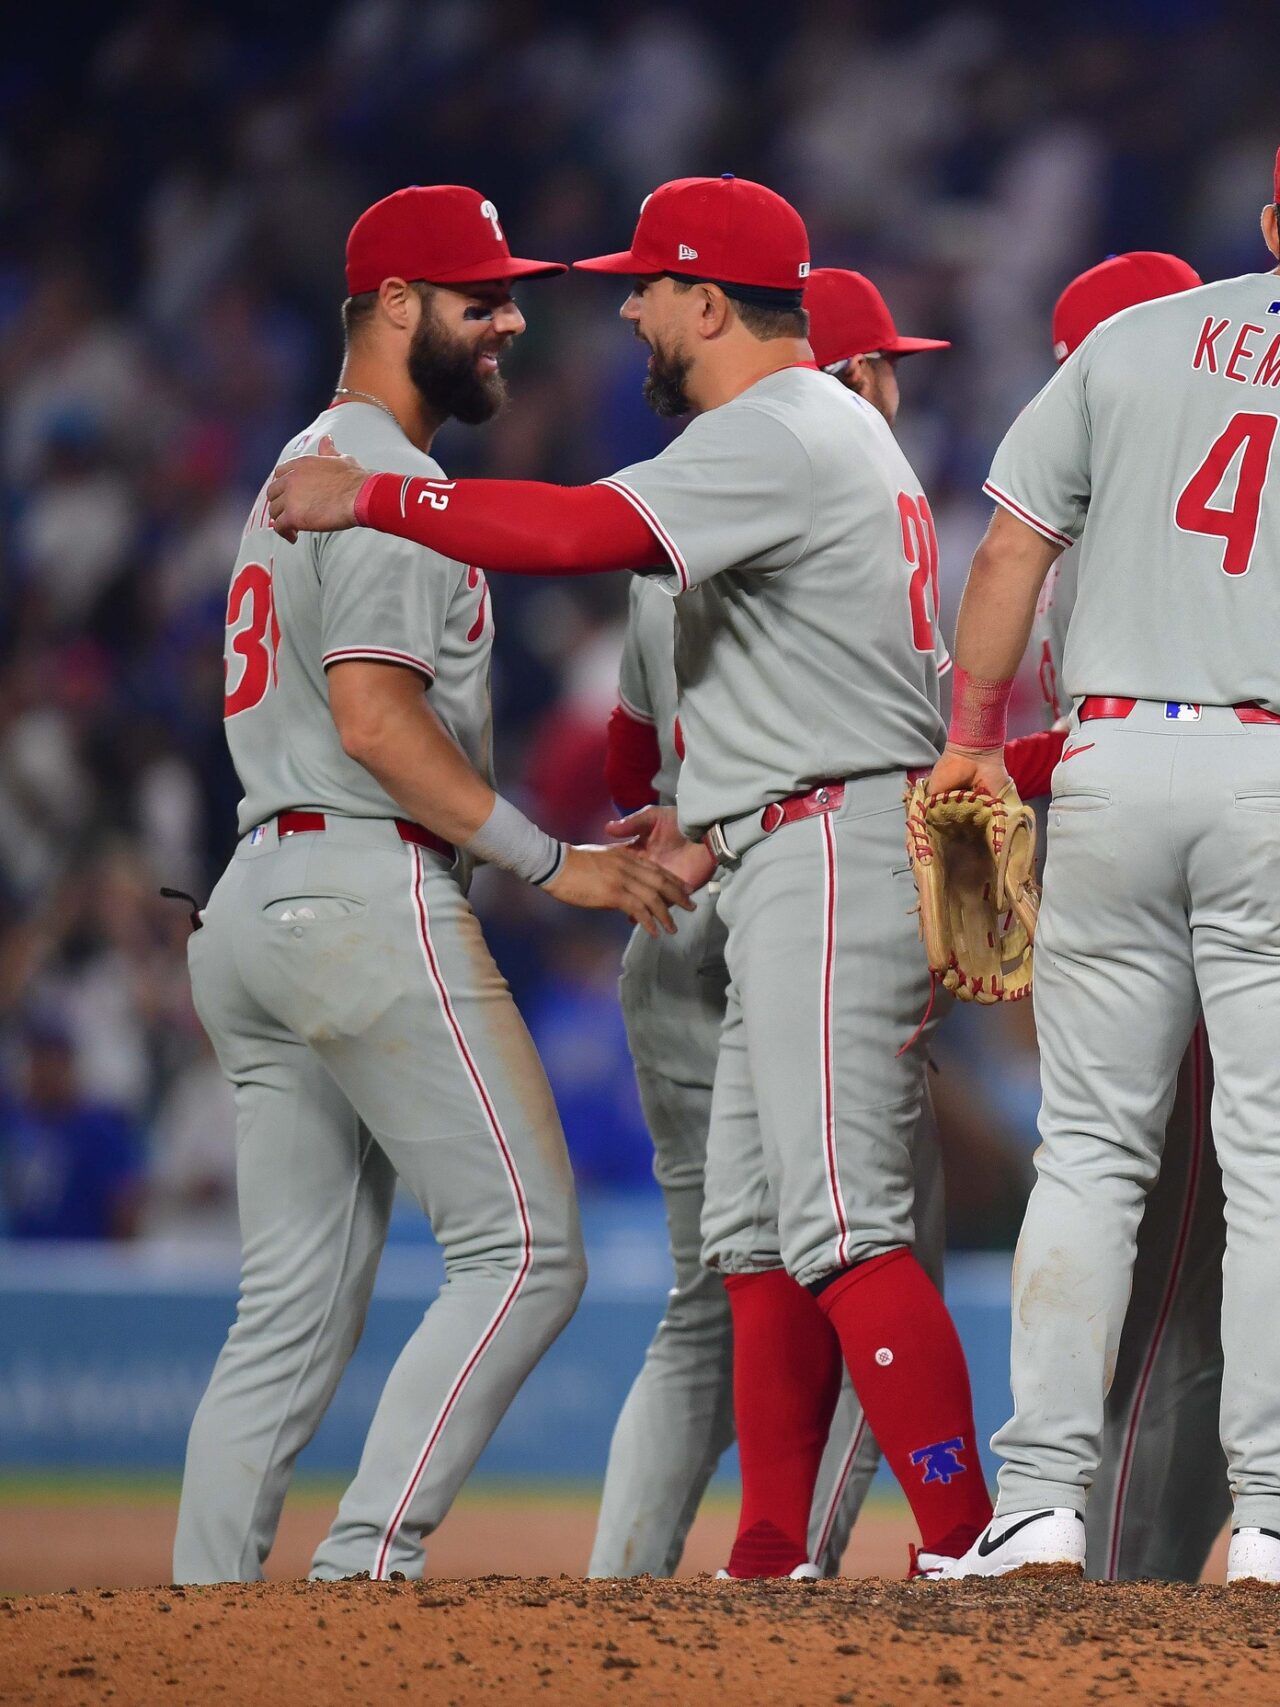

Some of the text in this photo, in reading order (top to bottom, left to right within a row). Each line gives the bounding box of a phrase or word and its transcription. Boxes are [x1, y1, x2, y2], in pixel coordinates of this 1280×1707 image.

[417, 481, 458, 511] 12
[1174, 410, 1280, 577] 4
[223, 555, 282, 721] 3
